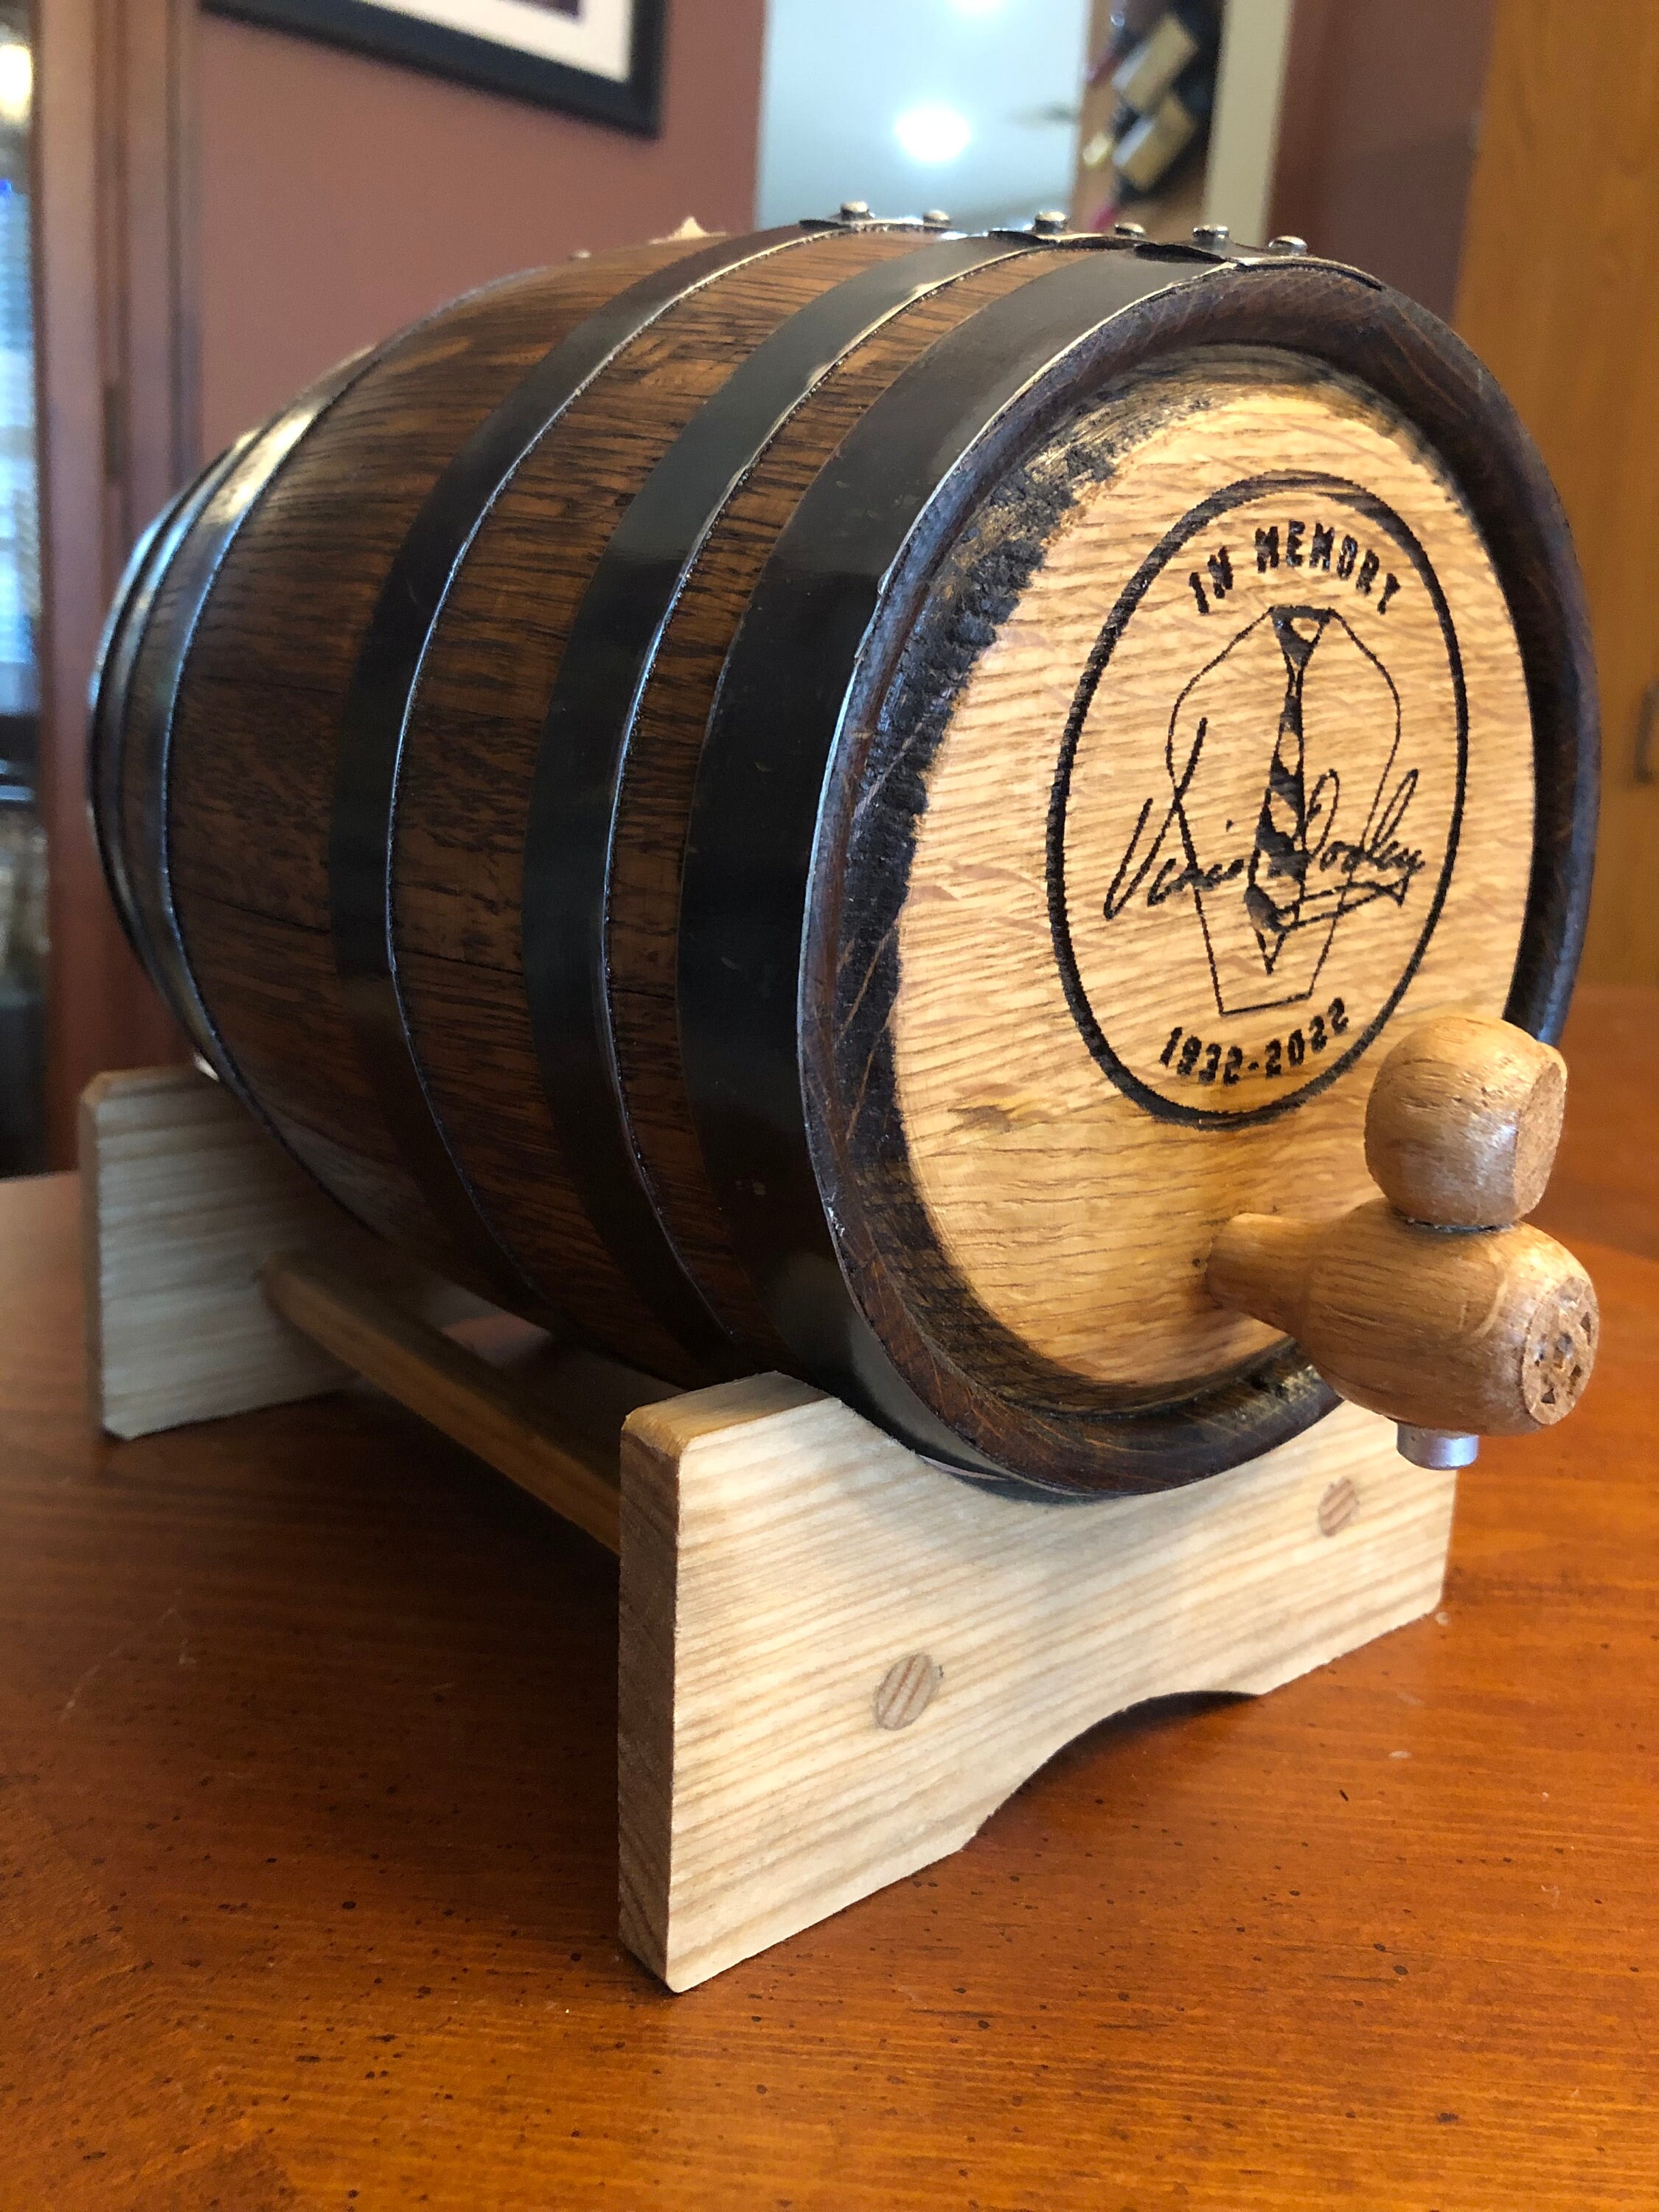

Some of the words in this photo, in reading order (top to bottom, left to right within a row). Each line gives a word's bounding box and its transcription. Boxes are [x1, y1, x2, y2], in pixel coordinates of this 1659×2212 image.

[1189, 546, 1234, 613] IN
[1255, 520, 1400, 614] MEMORY
[1160, 998, 1349, 1085] 1932-2022
